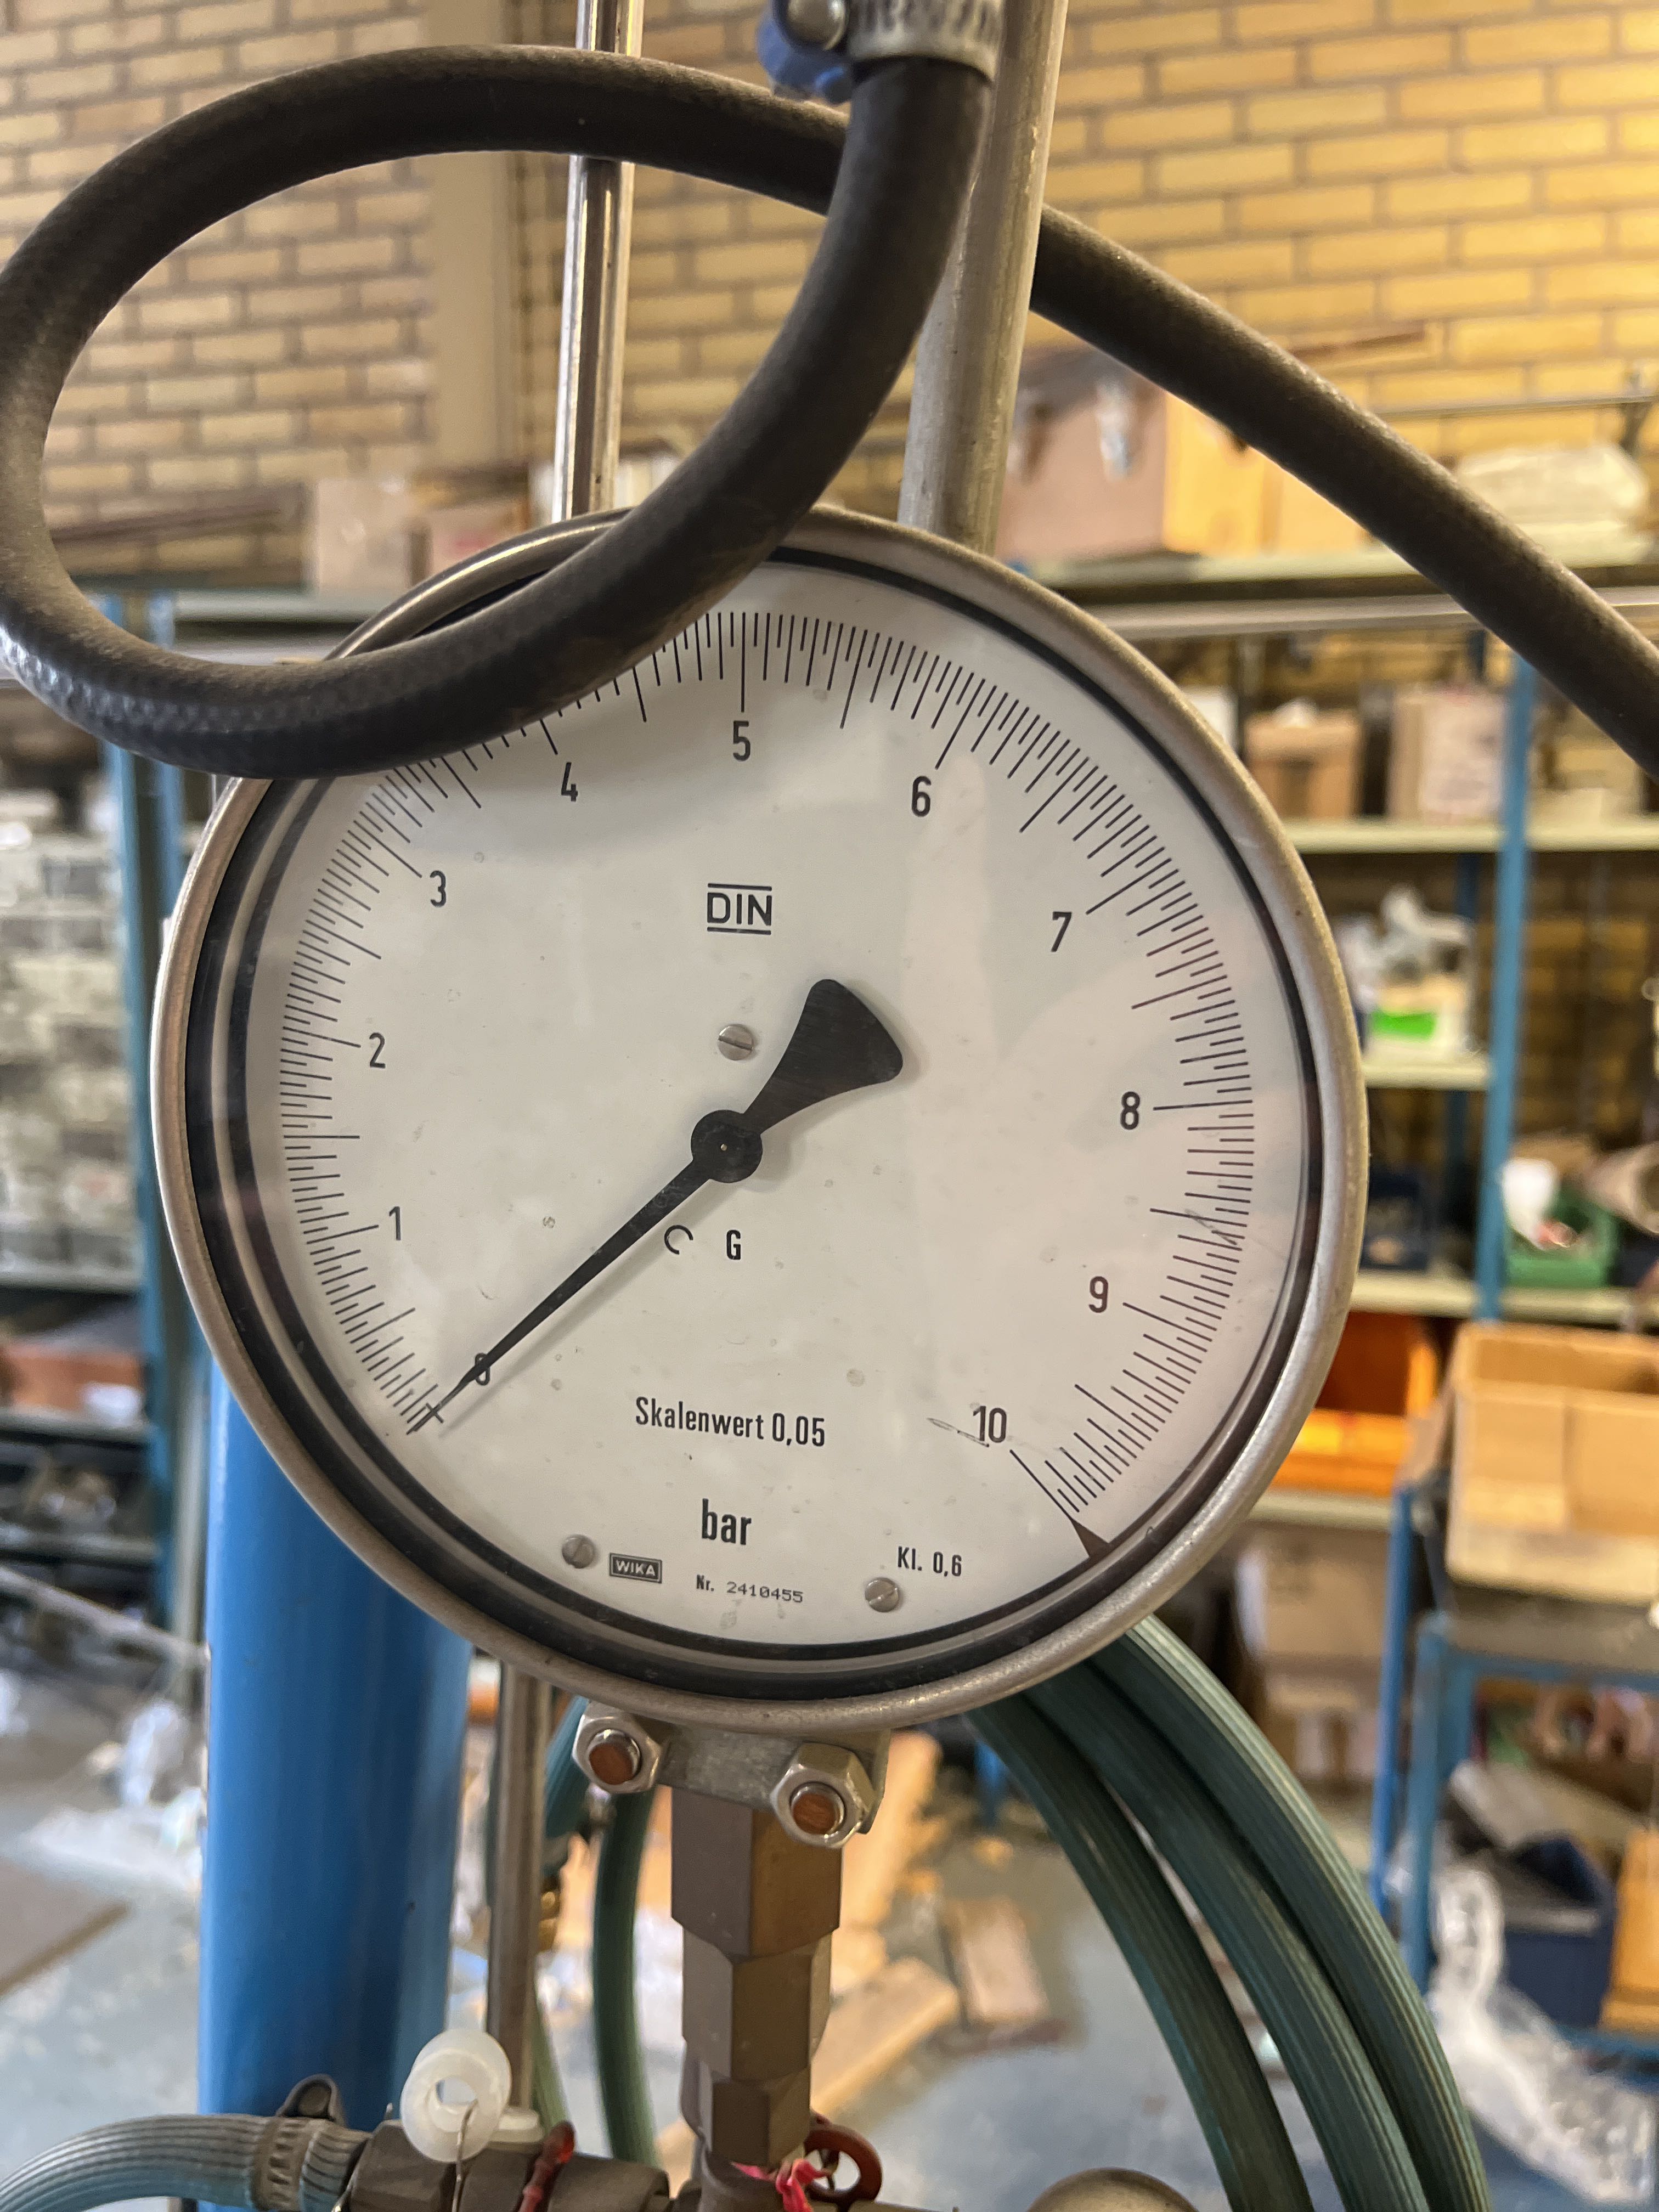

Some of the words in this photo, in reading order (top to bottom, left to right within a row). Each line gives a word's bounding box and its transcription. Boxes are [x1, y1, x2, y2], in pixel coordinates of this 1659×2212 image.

[732, 720, 751, 761] 5
[561, 761, 578, 802] 4
[911, 775, 932, 817] 6
[430, 870, 447, 907] 3
[707, 891, 773, 927] DIN
[1051, 911, 1073, 952] 7
[369, 1032, 386, 1069] 2
[1120, 1091, 1141, 1130] 8
[388, 1206, 401, 1241] 1
[726, 1229, 741, 1260] G
[1088, 1276, 1109, 1313] 9
[635, 1396, 764, 1440] Skalenwert
[772, 1413, 825, 1447] 0,05
[972, 1405, 1008, 1443] 10
[701, 1498, 752, 1545] bar
[615, 1559, 656, 1577] WIKA
[933, 1551, 962, 1577] 0,6
[696, 1574, 714, 1592] Nr.
[726, 1581, 804, 1604] 2410455
